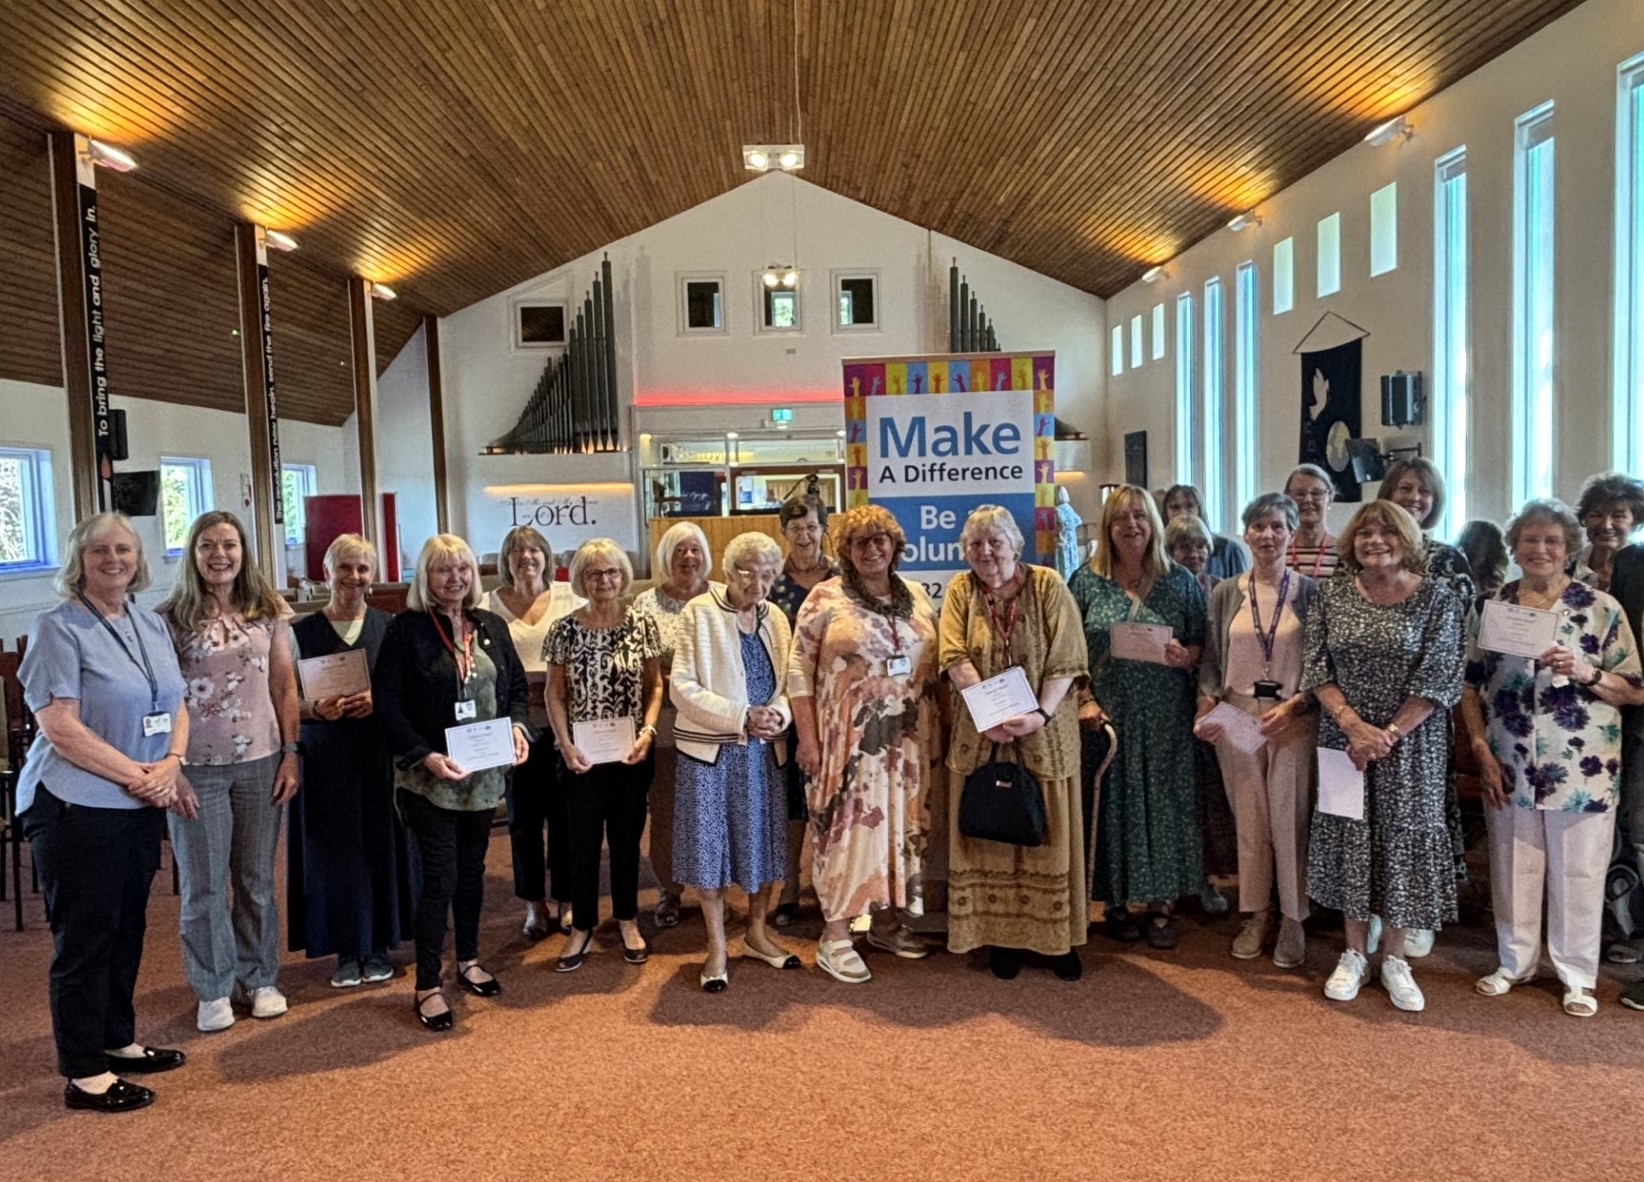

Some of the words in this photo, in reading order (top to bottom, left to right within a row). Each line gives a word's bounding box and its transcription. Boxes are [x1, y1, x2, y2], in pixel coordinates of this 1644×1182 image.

[88, 227, 100, 269] glory
[89, 274, 101, 306] and
[91, 309, 104, 342] light
[94, 347, 104, 372] the
[95, 376, 107, 417] bring
[98, 419, 109, 437] To
[879, 411, 1021, 458] Make
[879, 465, 896, 483] A
[904, 462, 1023, 483] Difference
[510, 496, 596, 526] Lord.
[920, 505, 957, 530] Be
[900, 535, 965, 563] olun
